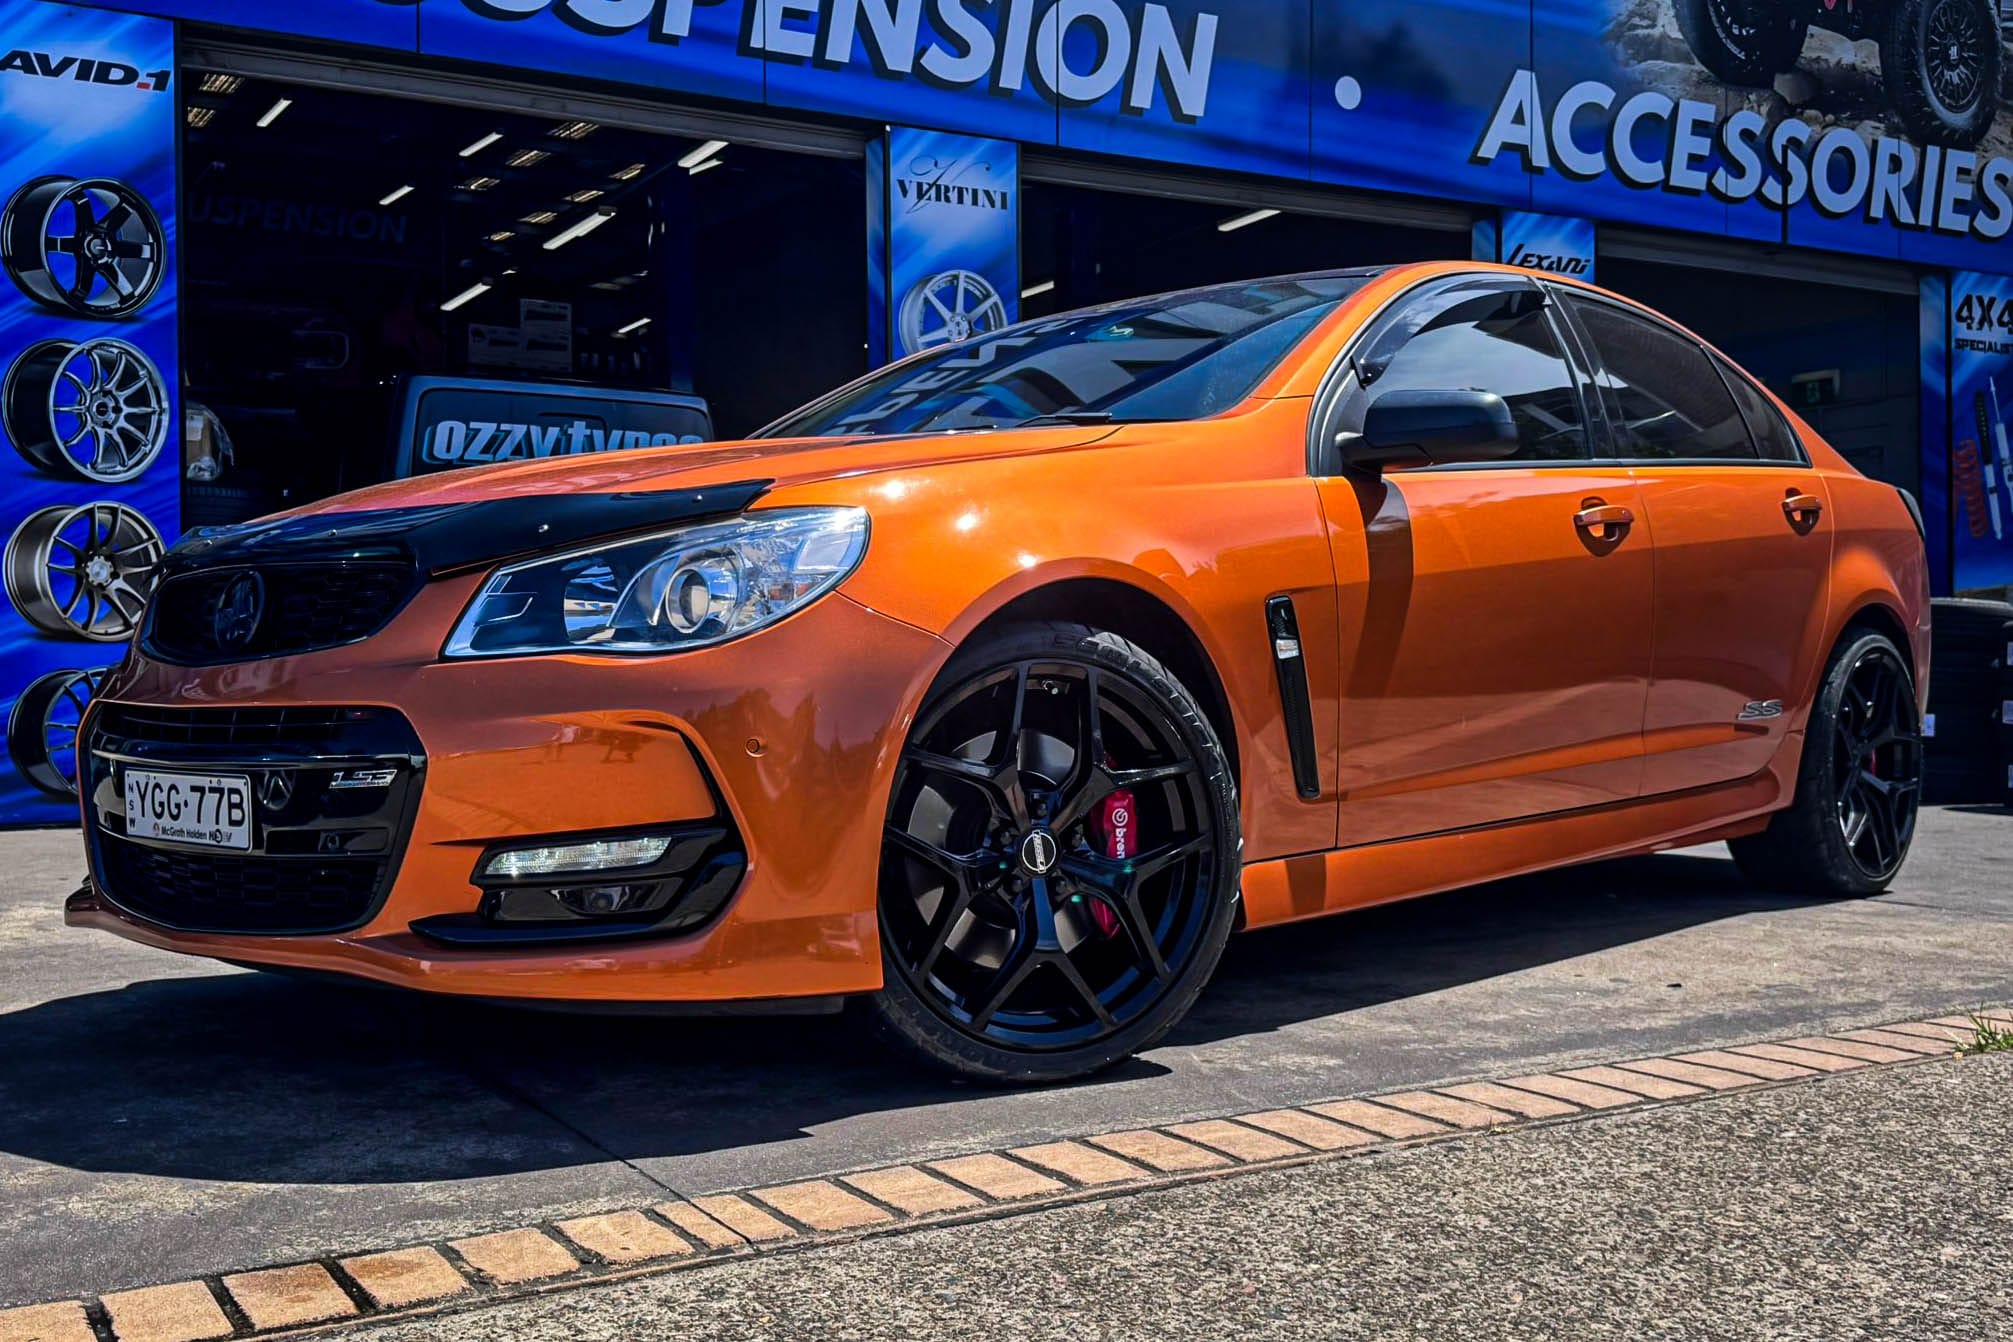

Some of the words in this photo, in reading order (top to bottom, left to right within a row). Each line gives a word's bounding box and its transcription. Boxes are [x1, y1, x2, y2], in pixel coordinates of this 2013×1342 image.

[0, 49, 171, 92] AVID.1
[1477, 69, 2013, 238] ACCESSORIES
[896, 179, 1008, 210] VERTINI
[1737, 699, 1783, 720] SS
[1115, 827, 1127, 859] brem
